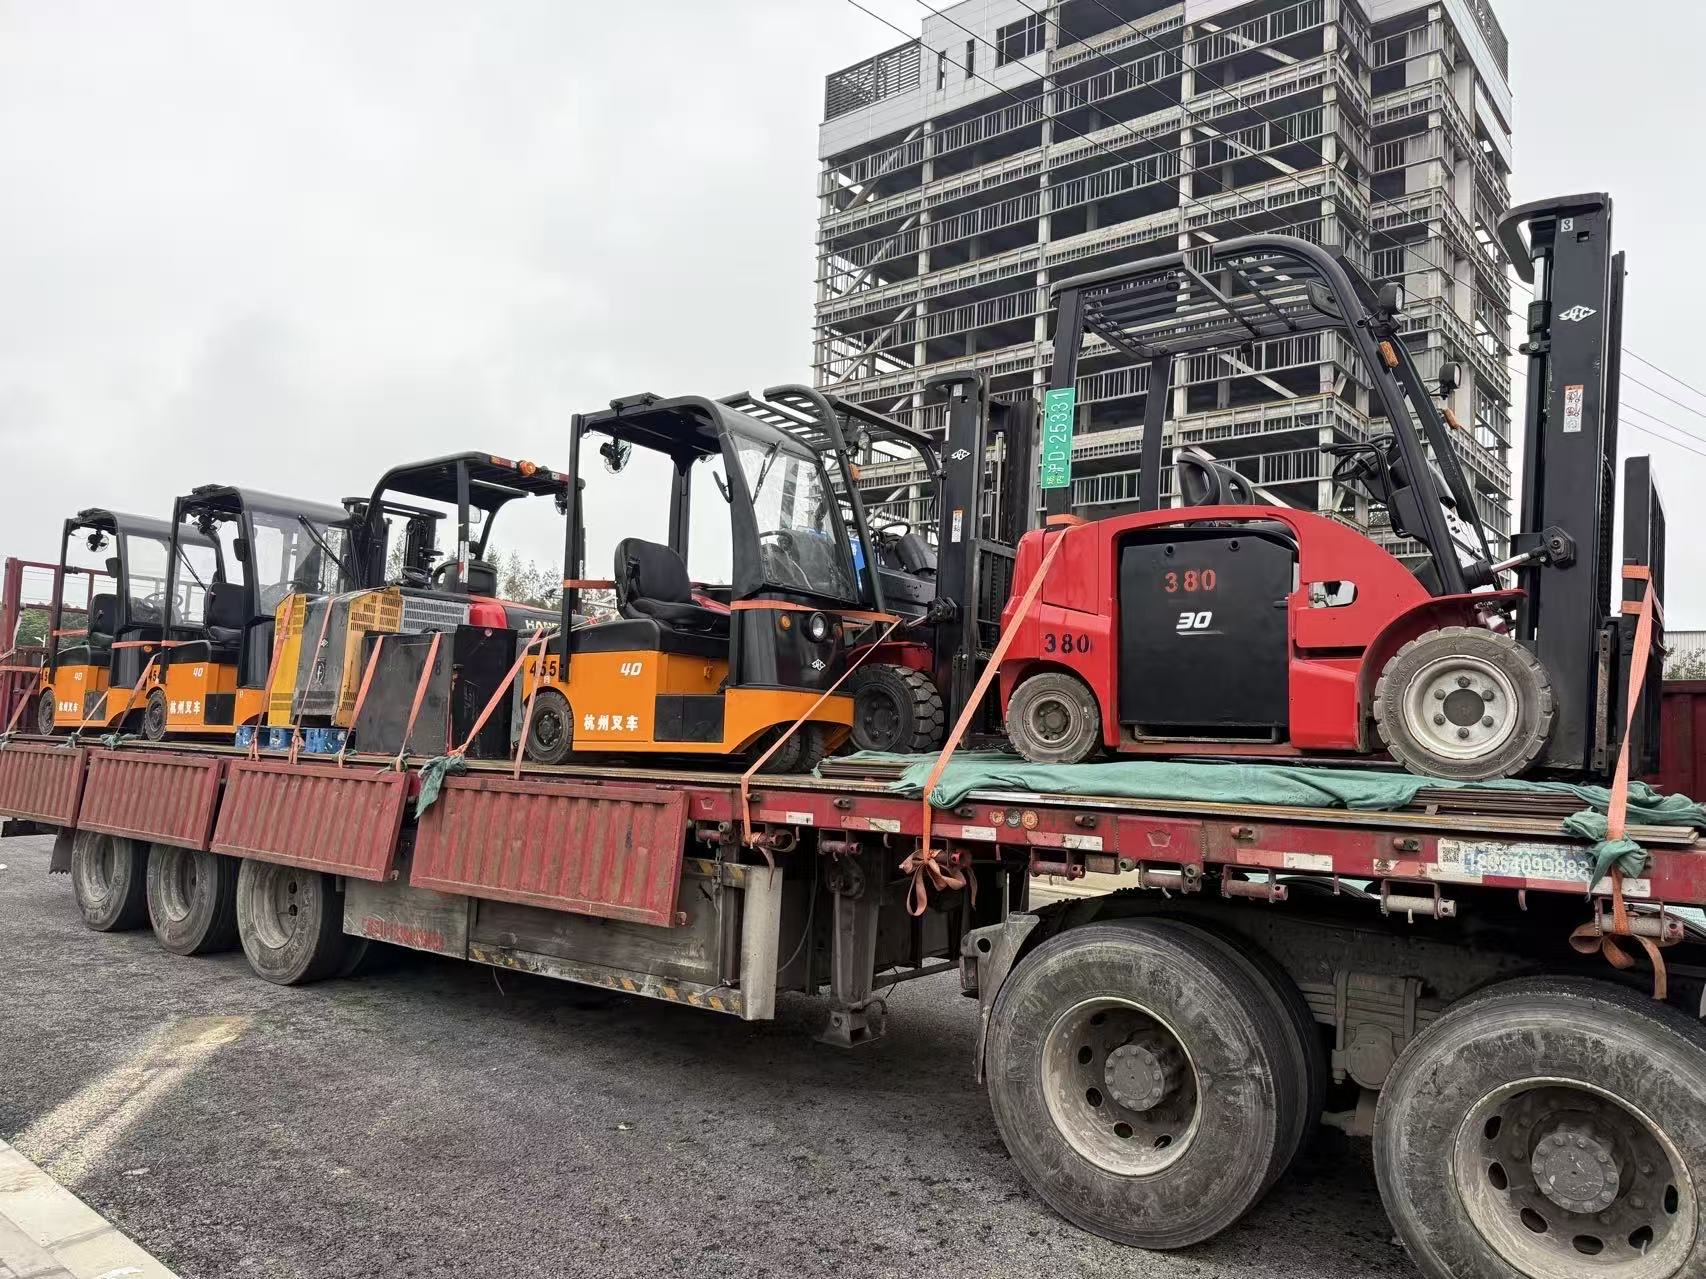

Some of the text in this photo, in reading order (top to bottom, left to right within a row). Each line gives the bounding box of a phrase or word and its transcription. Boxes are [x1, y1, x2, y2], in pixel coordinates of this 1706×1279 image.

[1164, 568, 1217, 593] 380
[1175, 611, 1213, 629] 30
[1044, 633, 1090, 654] 380
[620, 662, 643, 676] 40
[169, 700, 201, 715] 杭州叉车
[583, 713, 639, 731] 杭州叉车
